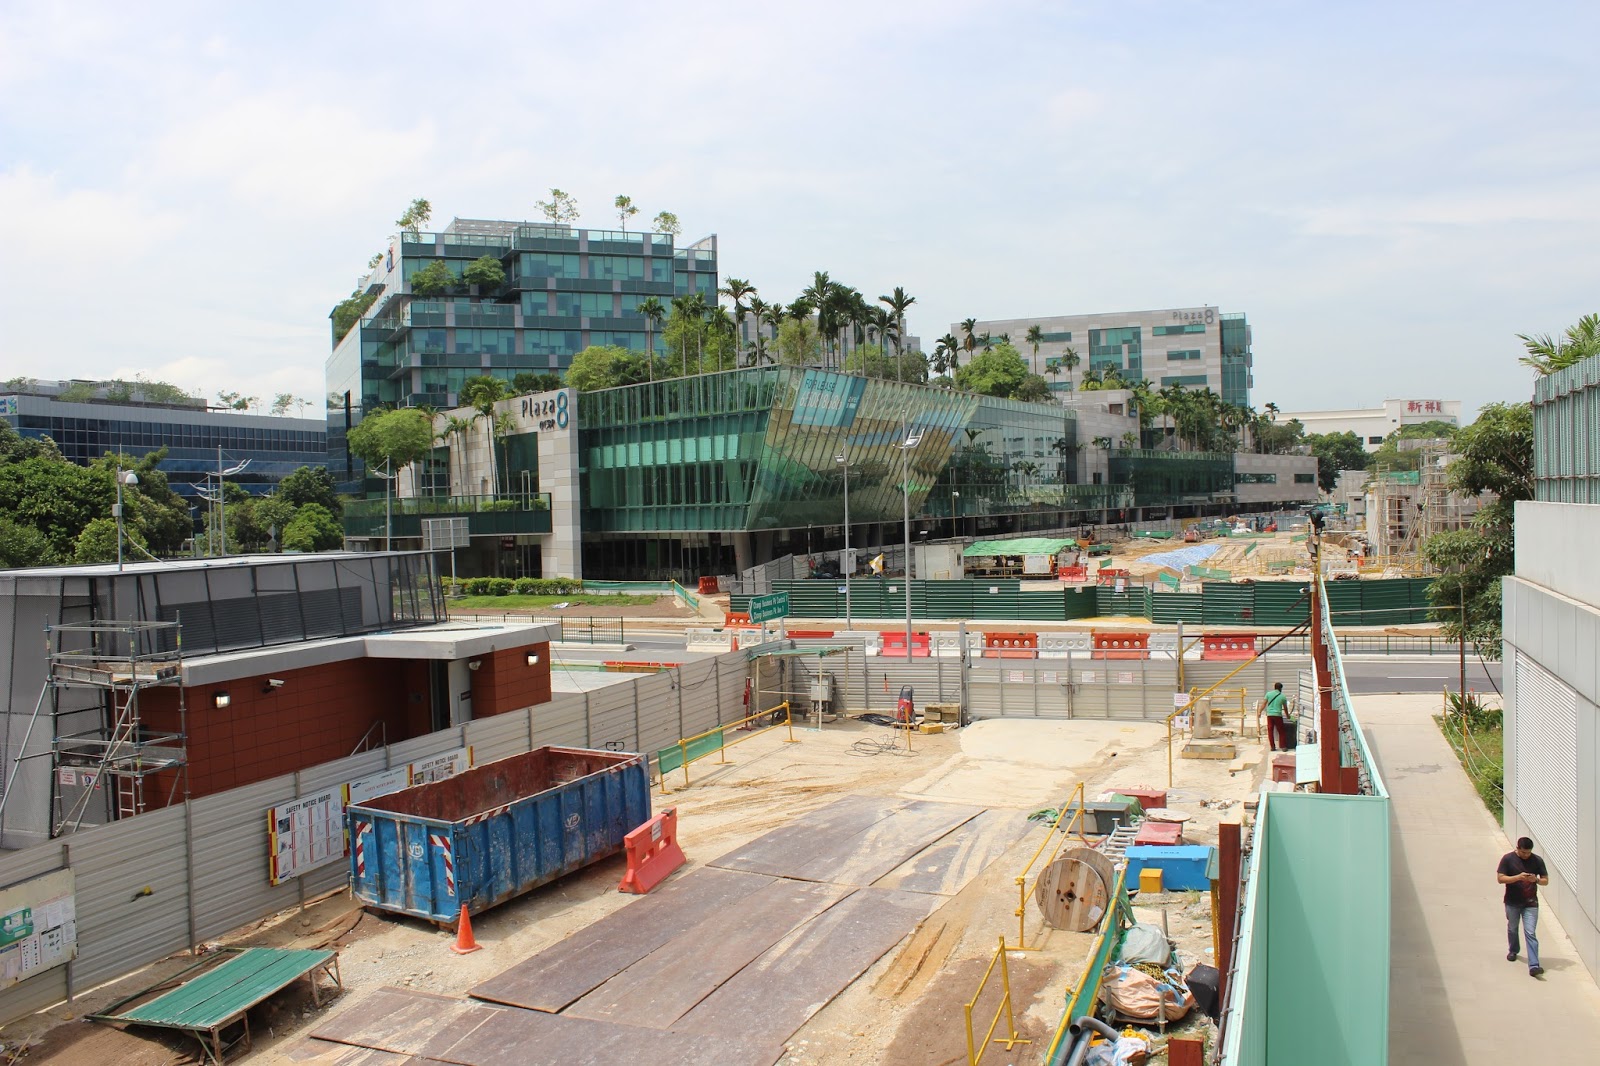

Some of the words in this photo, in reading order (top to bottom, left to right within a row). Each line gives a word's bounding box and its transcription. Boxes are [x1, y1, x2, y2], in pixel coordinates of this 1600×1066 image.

[1172, 311, 1203, 320] Plaza
[1205, 309, 1214, 324] 8
[805, 378, 817, 390] FOR
[817, 380, 836, 393] LEASE
[522, 397, 556, 418] Plaza
[556, 391, 569, 429] 8
[421, 761, 434, 770] SAFETY
[435, 757, 447, 766] NOTICE
[447, 754, 459, 762] BOARD
[286, 805, 301, 814] SAFETY
[302, 799, 317, 808] NOTICE
[318, 794, 331, 803] BOARD
